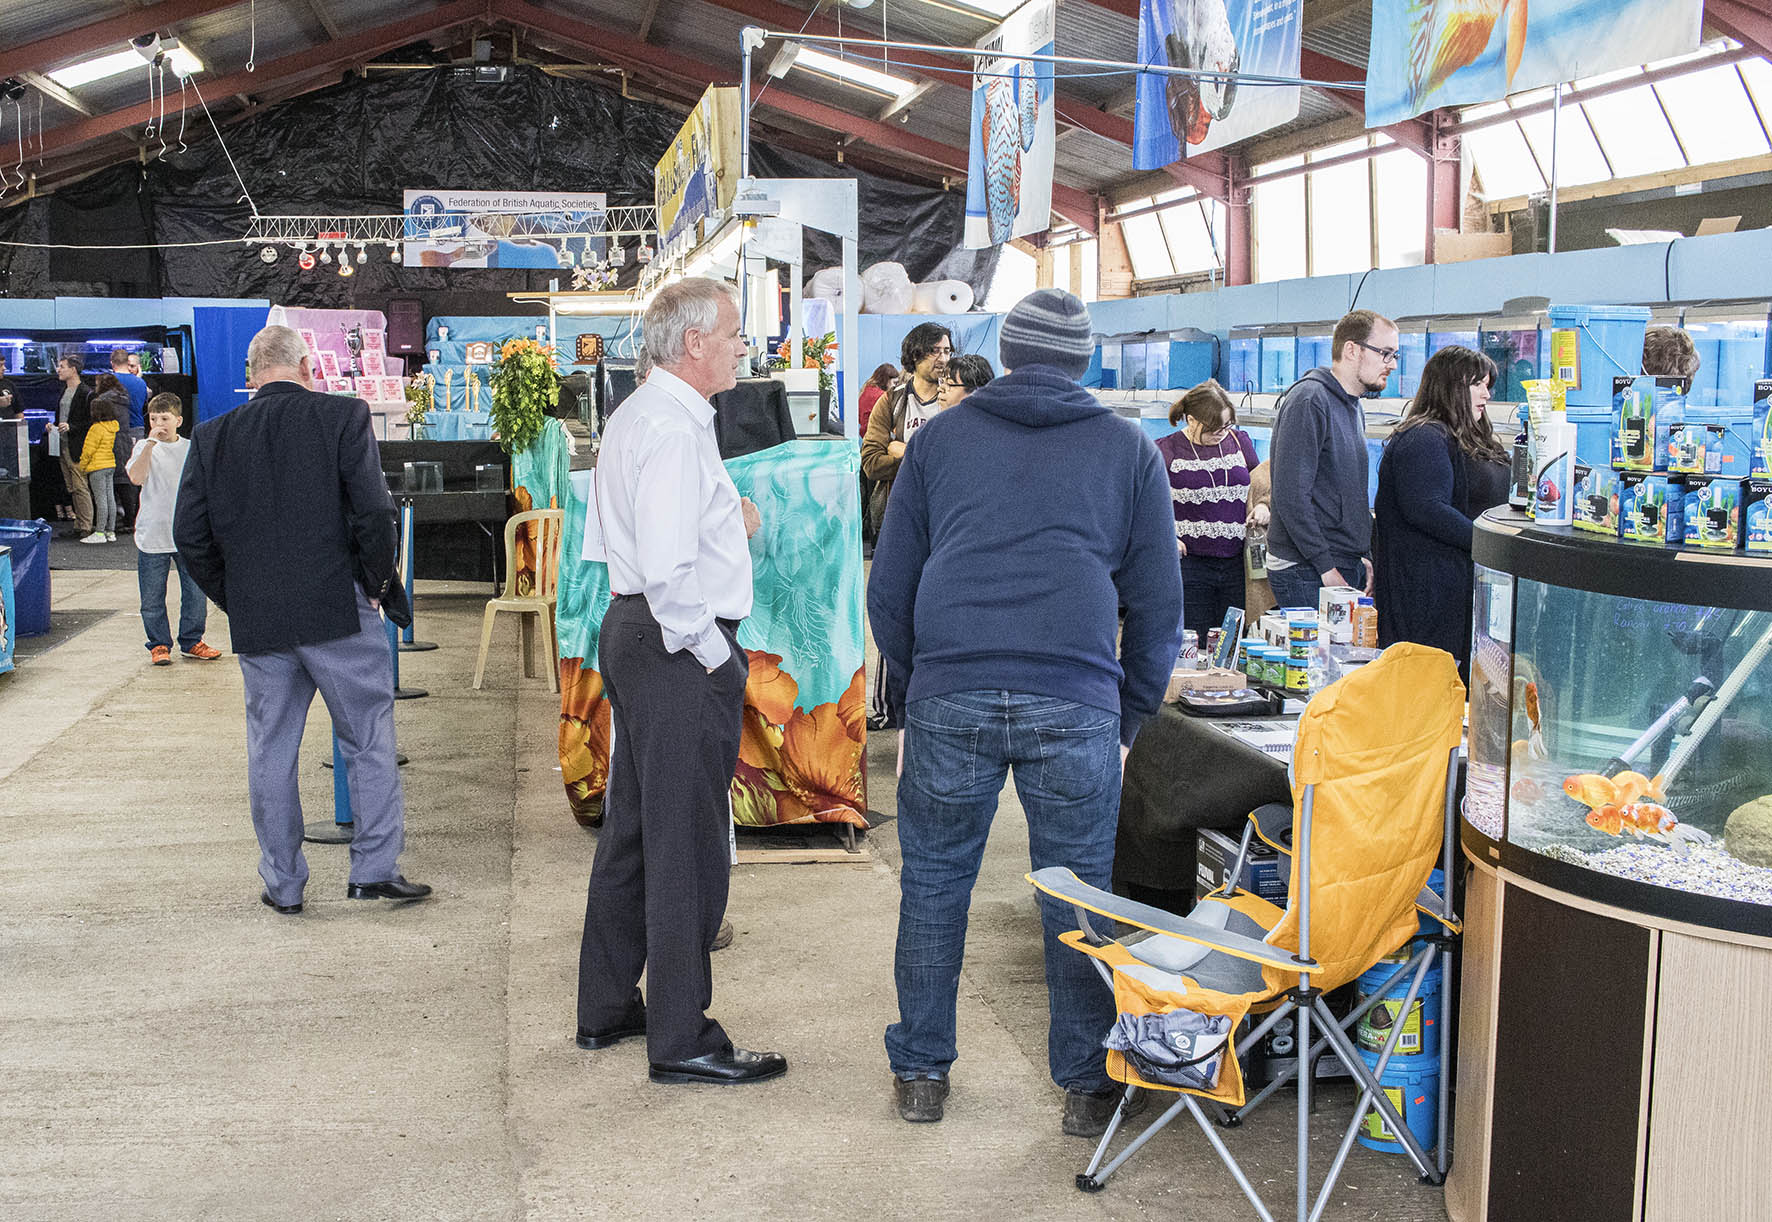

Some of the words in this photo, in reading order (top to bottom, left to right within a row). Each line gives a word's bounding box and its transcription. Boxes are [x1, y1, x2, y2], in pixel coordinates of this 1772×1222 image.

[448, 197, 491, 208] Federation
[492, 198, 501, 207] of
[502, 198, 528, 208] British
[529, 199, 559, 210] Aquatic
[561, 199, 598, 210] Societies
[1757, 383, 1772, 391] BOY
[1575, 468, 1588, 476] BOYU
